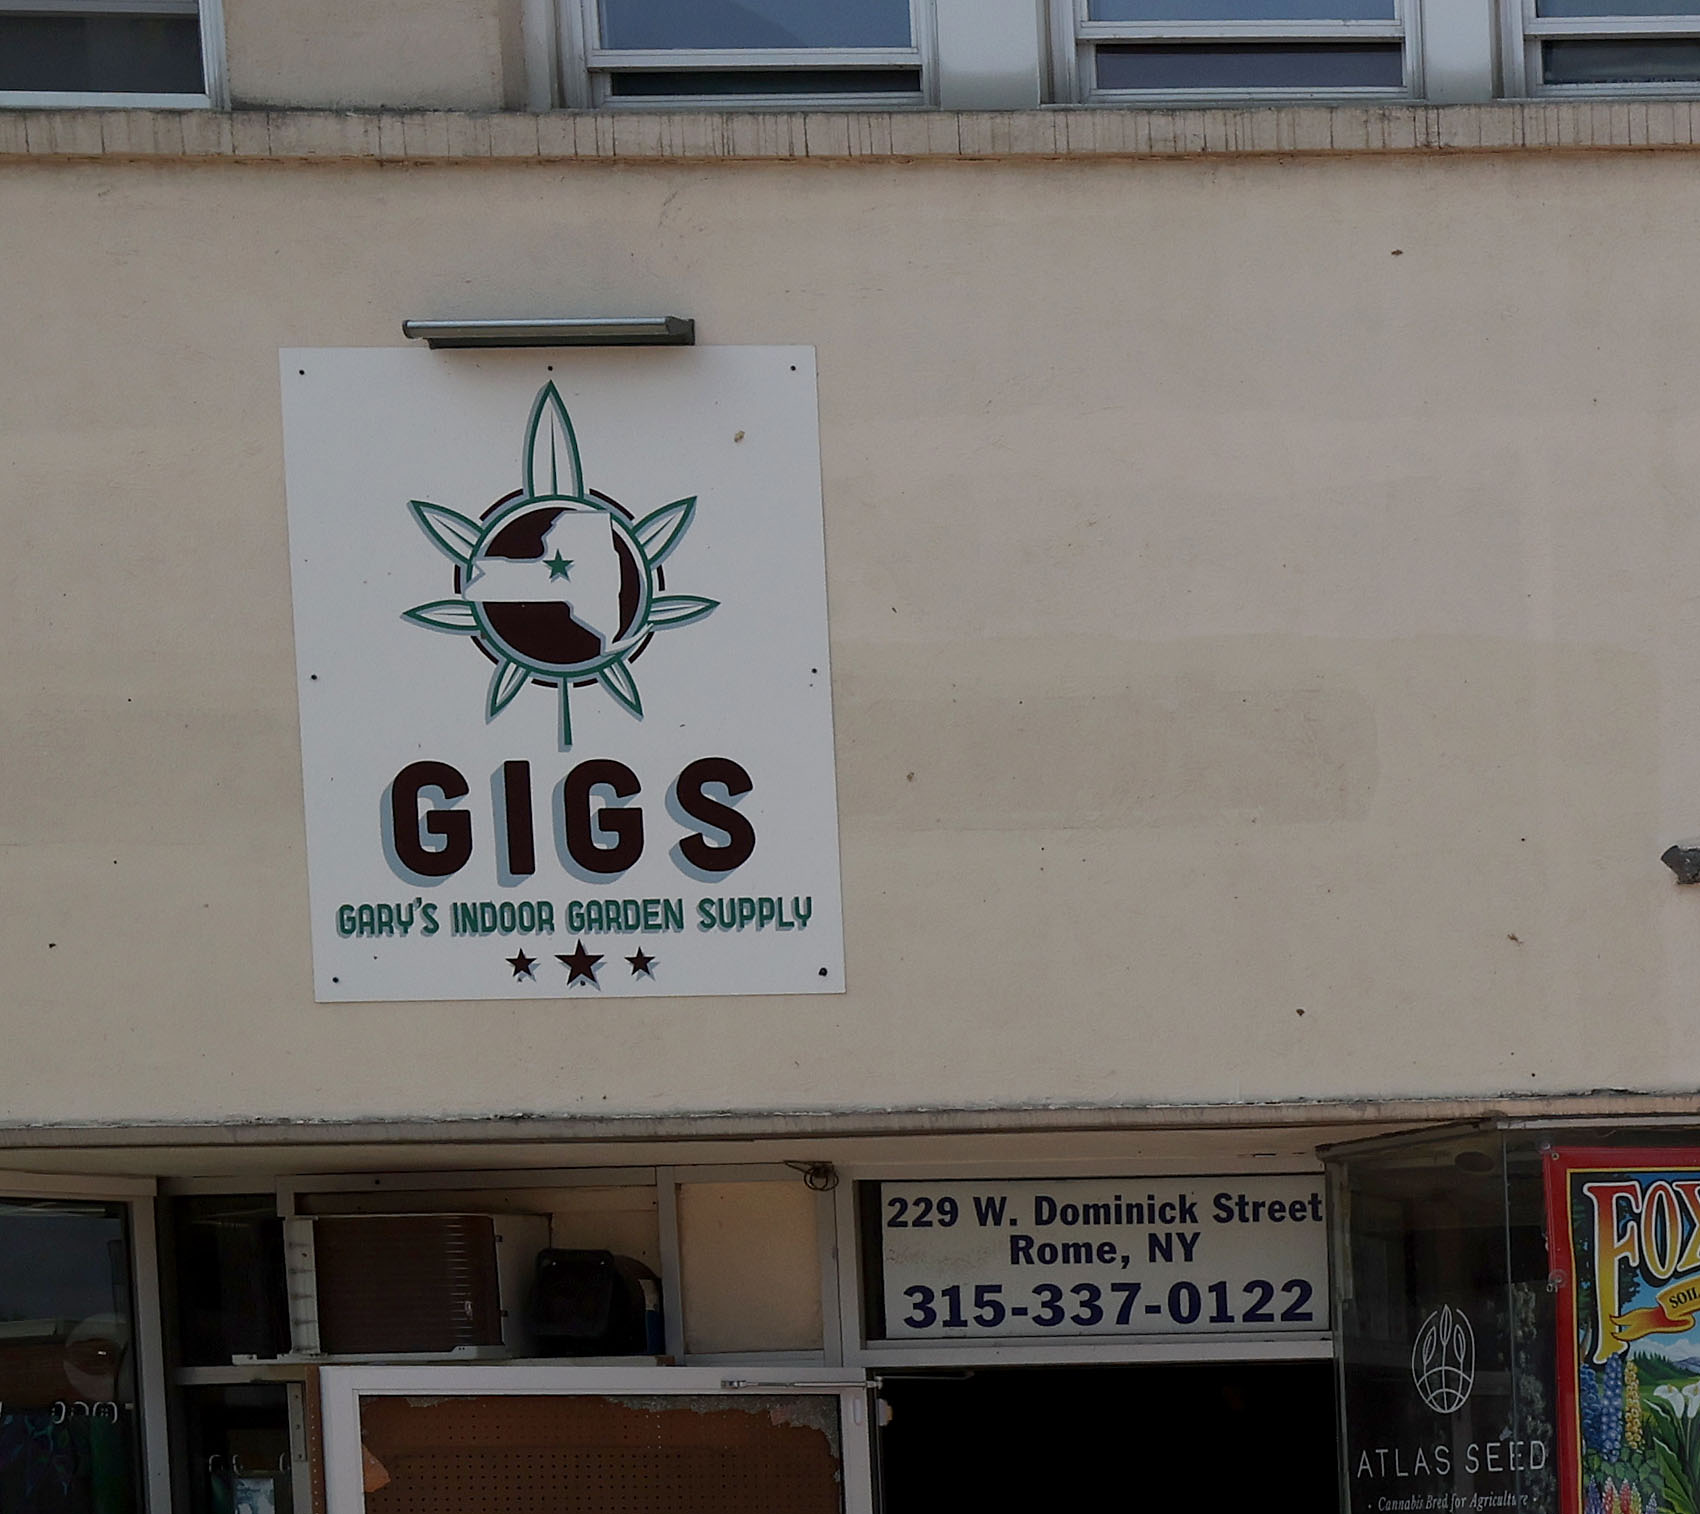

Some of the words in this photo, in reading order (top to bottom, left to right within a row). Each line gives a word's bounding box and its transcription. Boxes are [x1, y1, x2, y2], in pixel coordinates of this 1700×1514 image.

[386, 756, 756, 882] GIGS
[336, 896, 440, 937] GARY'S
[452, 900, 555, 935] INDOOR
[567, 897, 685, 933] GARDEN
[697, 895, 813, 930] SUPPLY
[886, 1196, 959, 1228] 229
[973, 1195, 1019, 1227] W.
[1034, 1192, 1199, 1226] Dominick
[1212, 1191, 1323, 1224] Street
[1009, 1233, 1131, 1269] Rome,
[1148, 1231, 1201, 1263] NY
[903, 1278, 1314, 1329] 315-337-0122
[1356, 1444, 1450, 1479] ATLAS
[1464, 1440, 1546, 1474] SEED
[1378, 1494, 1424, 1512] Cannabis
[1425, 1492, 1449, 1510] Bred
[1449, 1491, 1467, 1514] for
[1469, 1490, 1529, 1512] Agriculture
